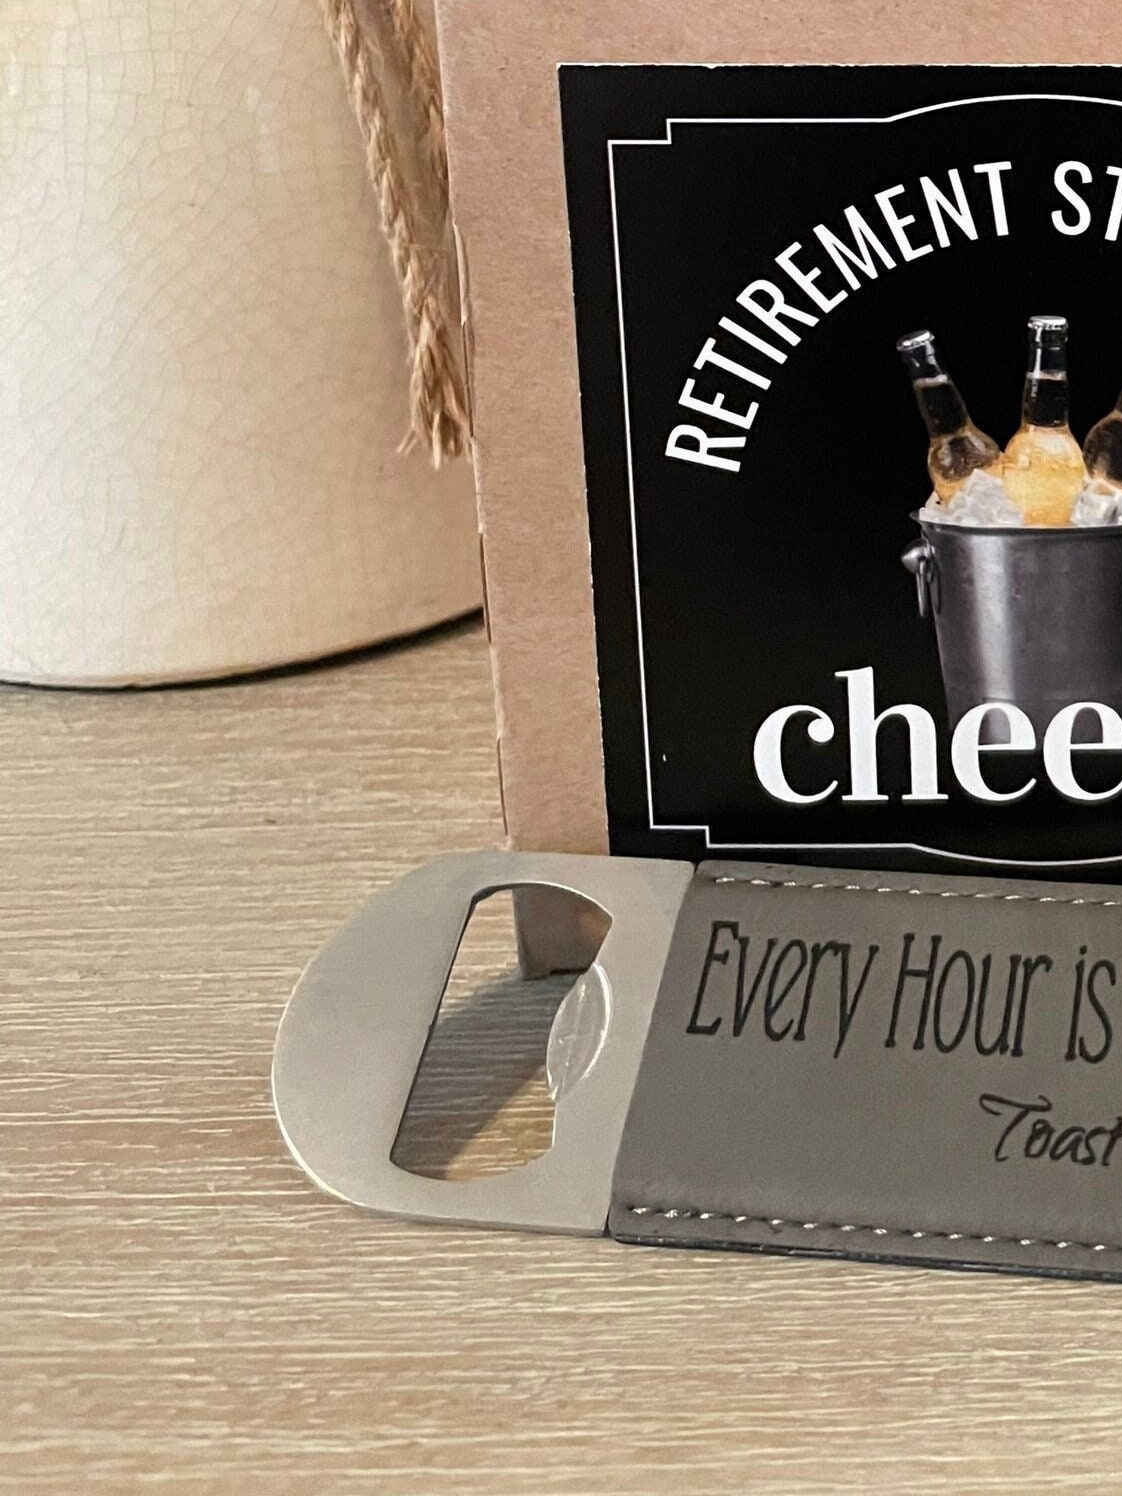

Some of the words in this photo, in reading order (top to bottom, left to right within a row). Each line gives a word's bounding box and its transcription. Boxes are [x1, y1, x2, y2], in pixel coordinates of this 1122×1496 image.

[664, 160, 1012, 473] RETIREMENT
[685, 920, 880, 1060] Every
[884, 932, 1054, 1058] Hour
[1064, 944, 1118, 1065] is
